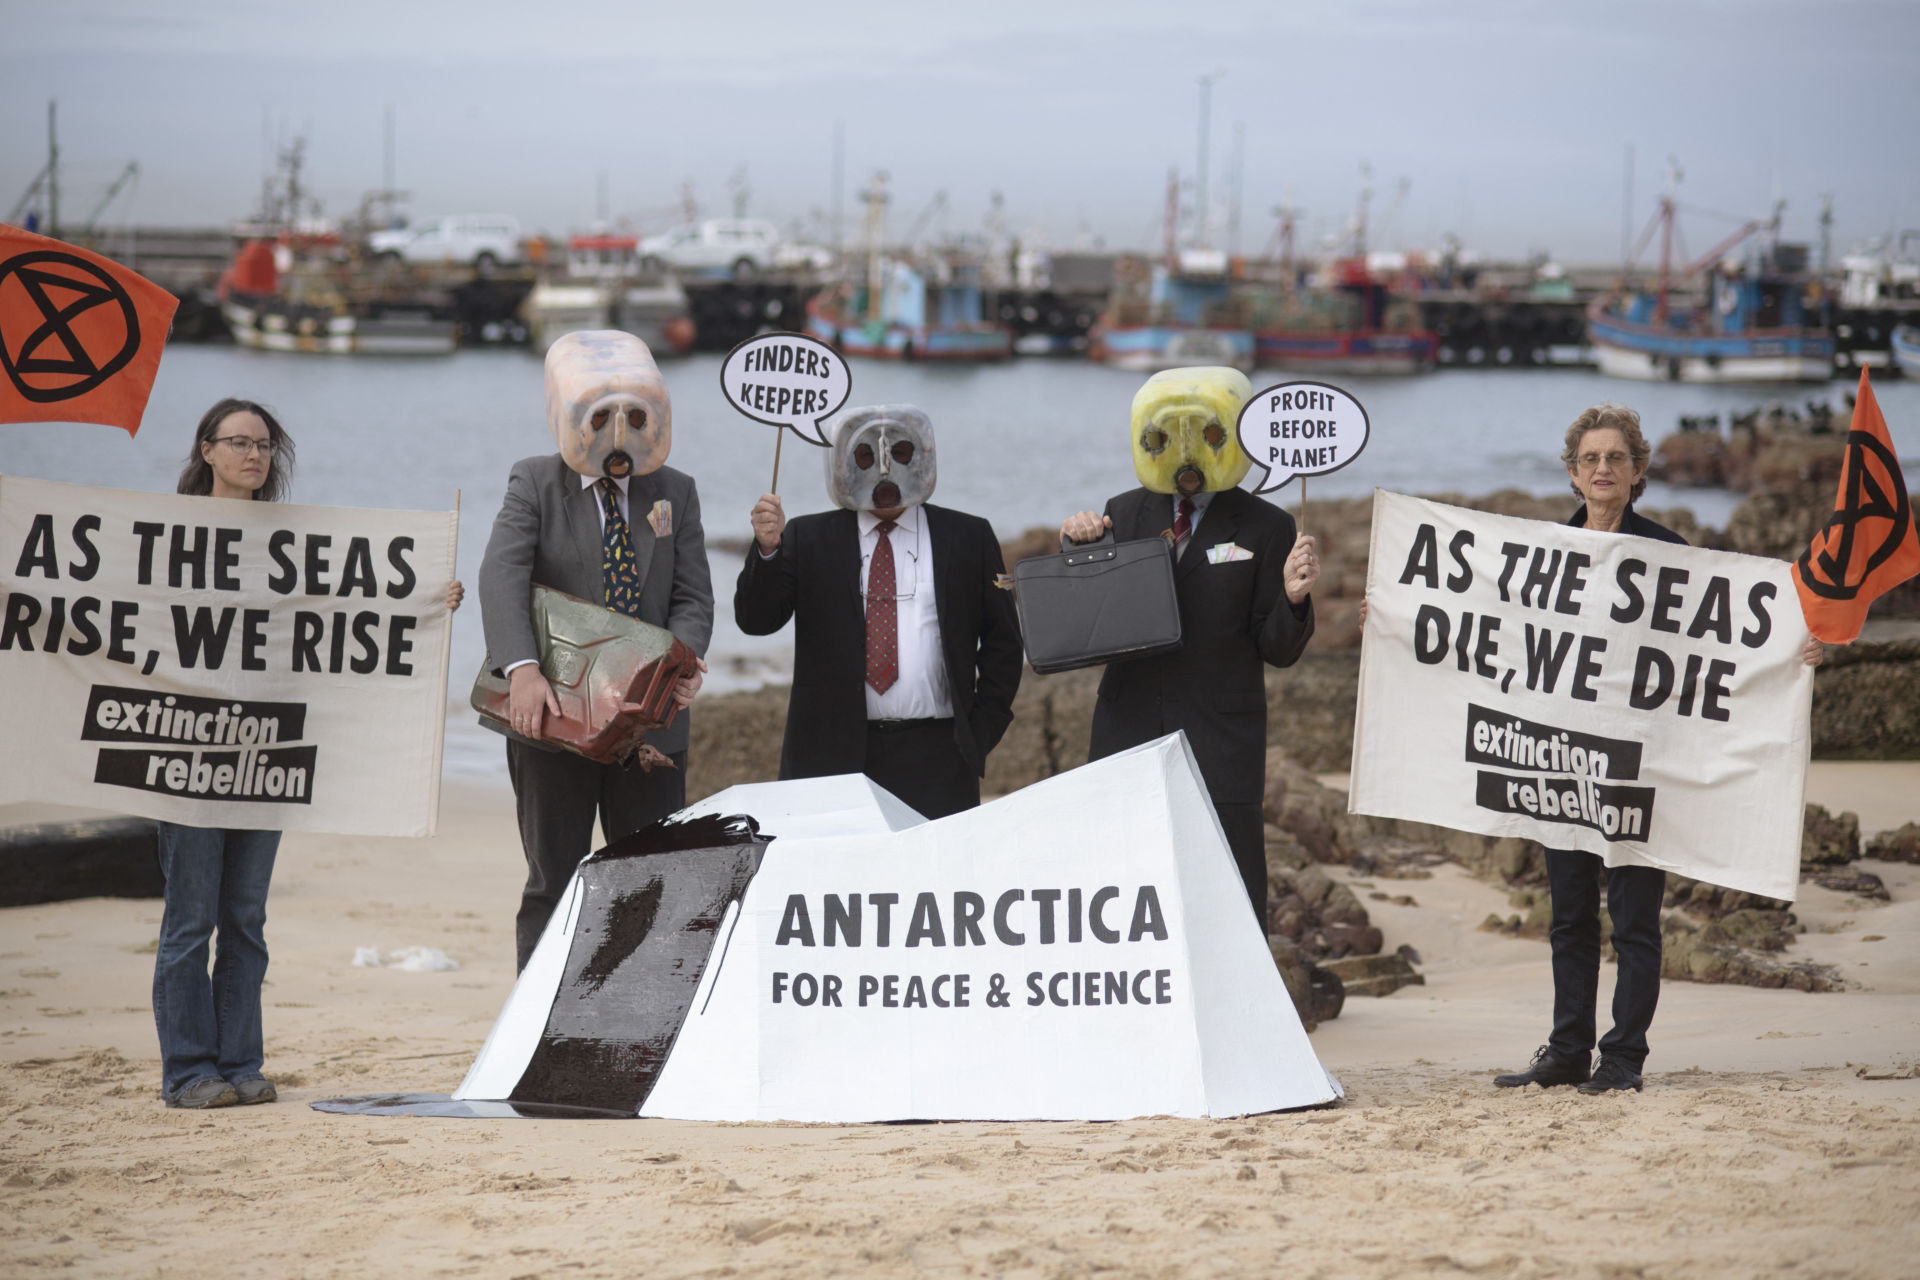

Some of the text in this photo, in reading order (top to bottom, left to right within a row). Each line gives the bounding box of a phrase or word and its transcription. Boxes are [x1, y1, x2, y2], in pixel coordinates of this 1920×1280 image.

[744, 345, 830, 379] FINDERS
[740, 382, 829, 415] KEEPERS
[1271, 390, 1335, 413] PROFIT
[1270, 419, 1337, 439] BEFORE
[1269, 445, 1338, 468] PLANET
[15, 514, 417, 599] AS THE SEAS
[1399, 523, 1778, 649] AS THE SEAS
[0, 592, 418, 676] RISE, WE RISE
[1413, 604, 1737, 722] DIE, WE DIE
[96, 696, 280, 745] extinction
[145, 749, 307, 798] rebellion
[1473, 719, 1609, 780] extinction
[1506, 776, 1644, 836] rebellion
[775, 885, 1169, 948] ANTARCTICA
[772, 968, 1172, 1008] FOR PEACE & SCIENCE
